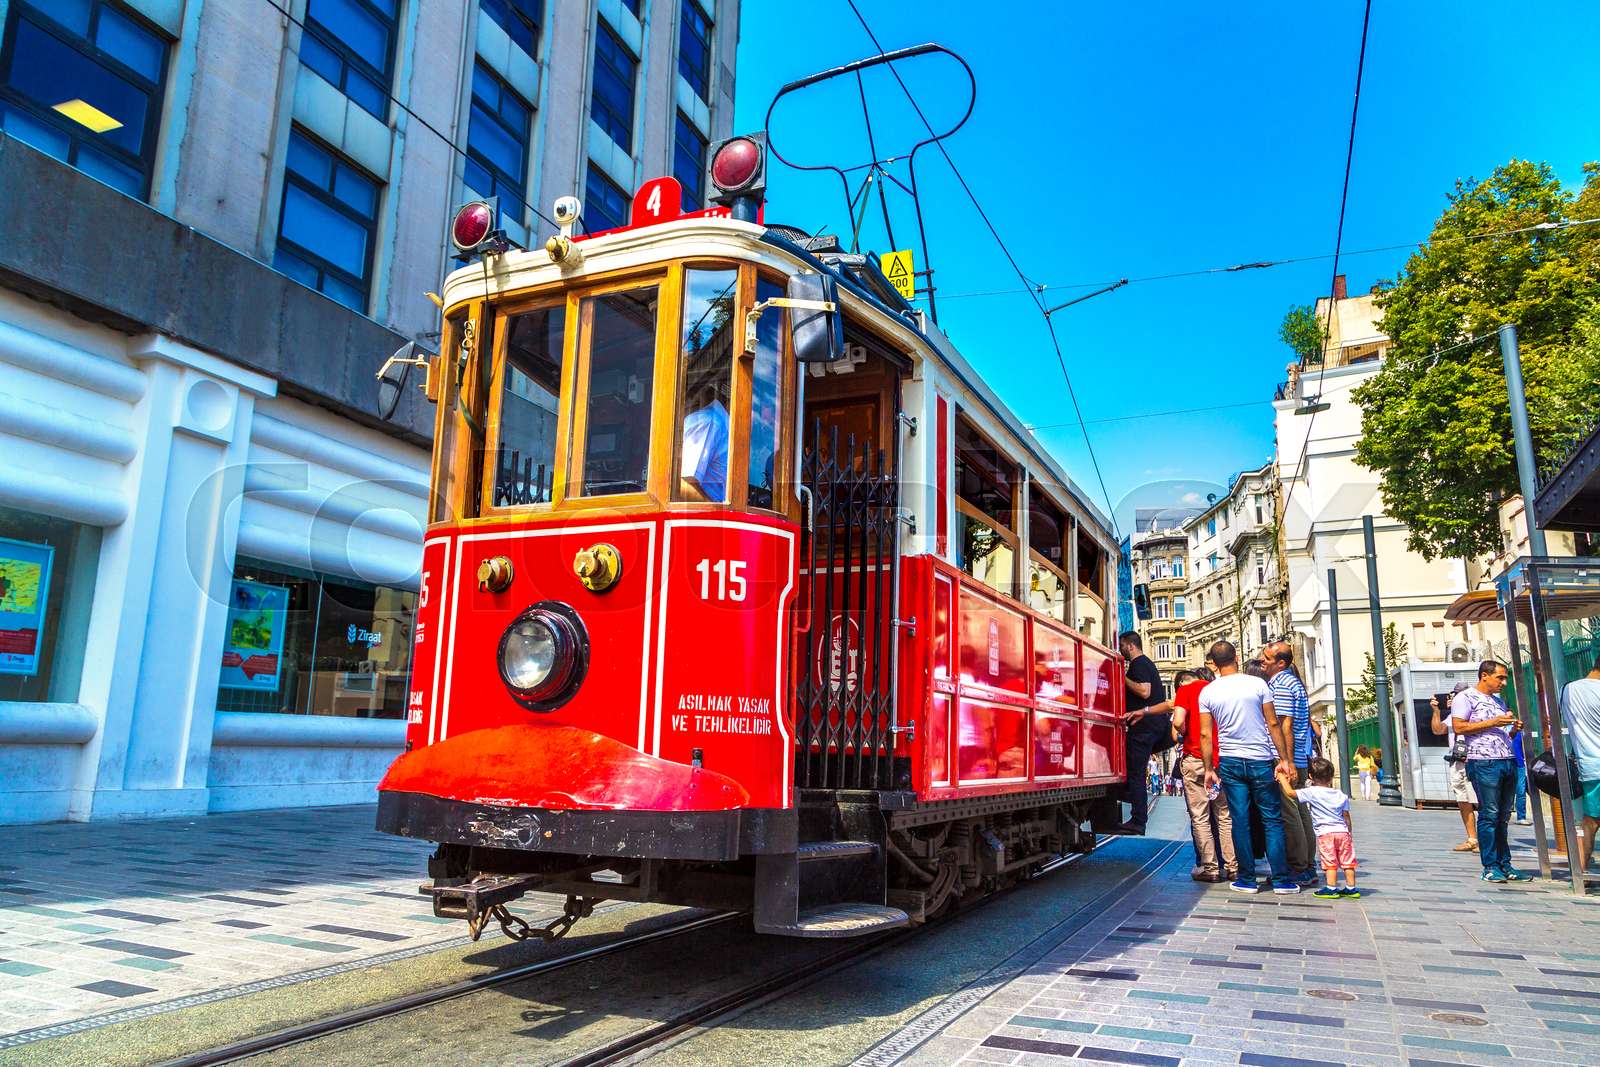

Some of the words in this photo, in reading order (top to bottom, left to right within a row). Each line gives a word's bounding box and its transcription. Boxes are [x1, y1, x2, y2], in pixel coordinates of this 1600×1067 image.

[646, 185, 661, 217] 4
[696, 559, 747, 602] 115
[357, 629, 382, 643] Ziraat
[678, 694, 732, 712] ASILMAK
[738, 696, 770, 714] YASAK
[672, 714, 688, 731] VE
[694, 714, 772, 735] TEHLİKELİDİR
